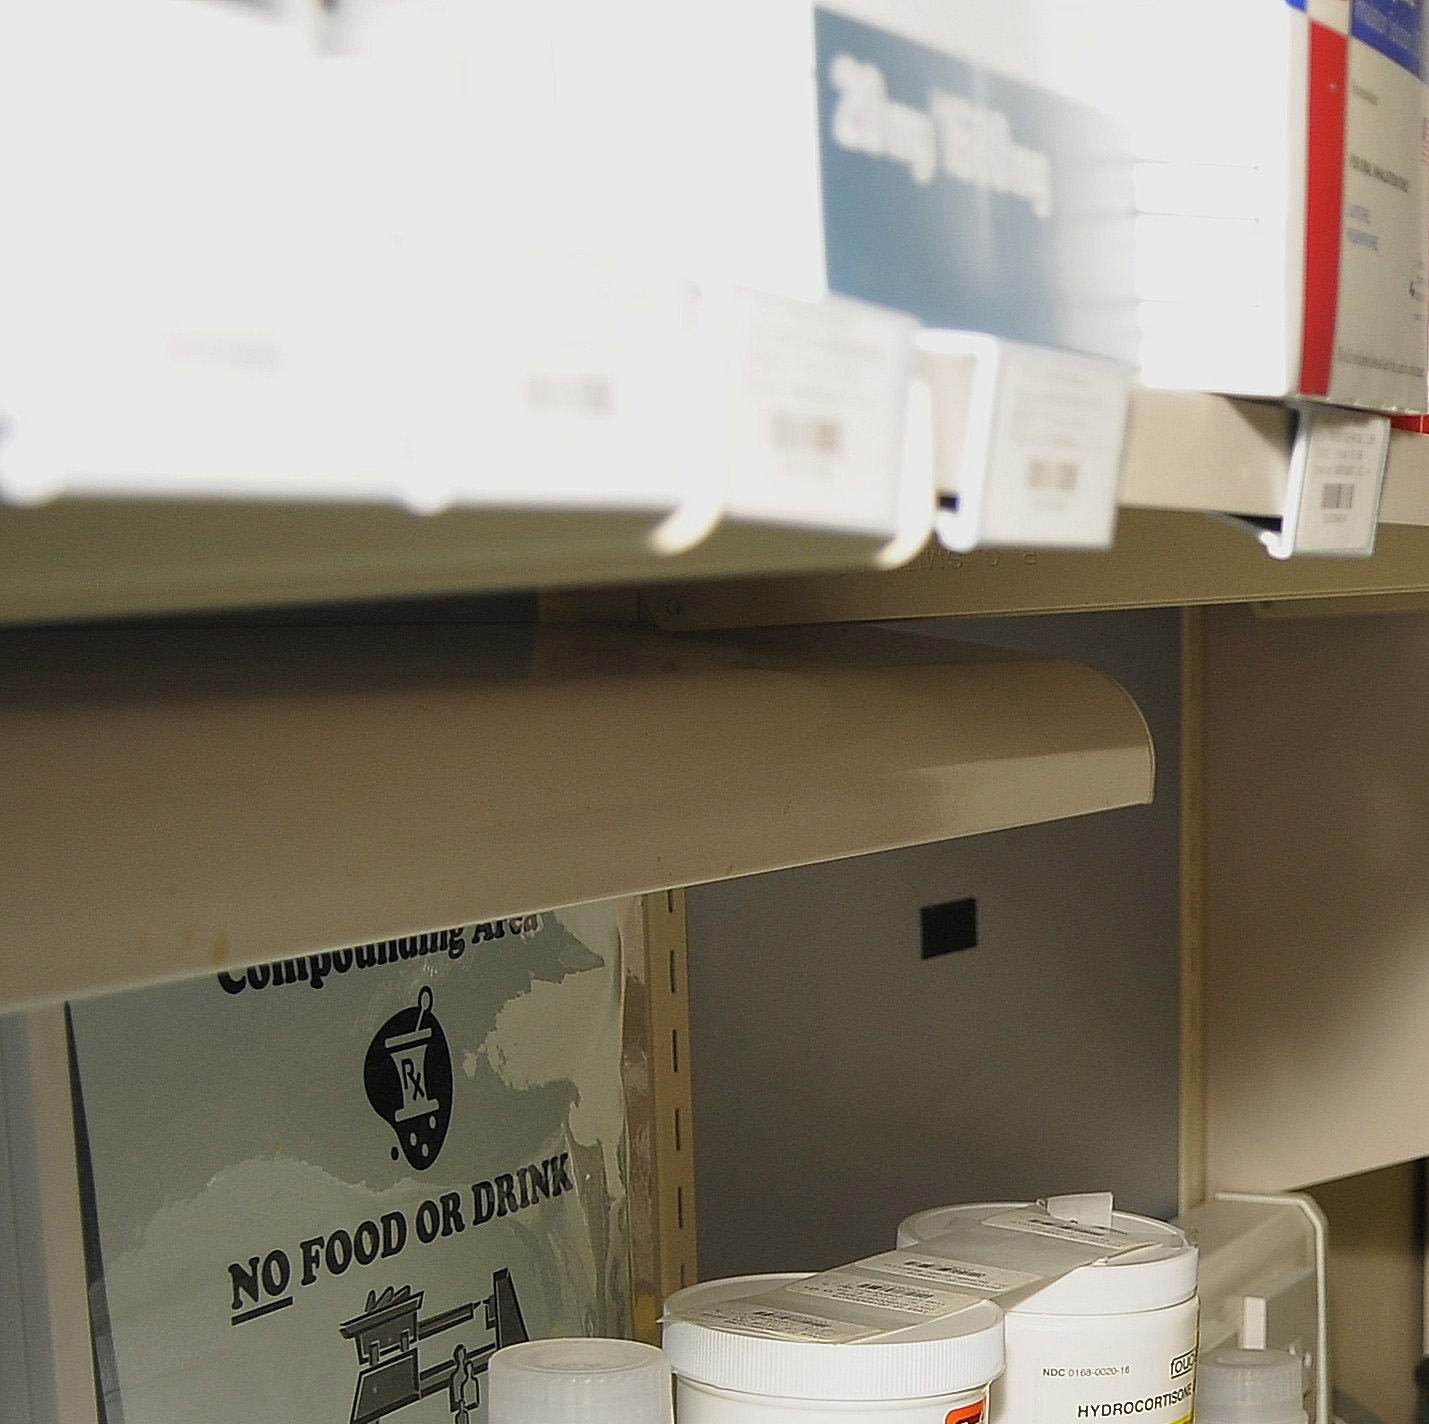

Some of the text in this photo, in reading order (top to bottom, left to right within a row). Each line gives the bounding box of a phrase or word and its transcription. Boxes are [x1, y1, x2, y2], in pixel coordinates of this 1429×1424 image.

[228, 1151, 575, 1314] NO FOOD OR DRINK
[1043, 1368, 1065, 1376] NDC
[1078, 1383, 1192, 1417] HYDROCORTISONE
